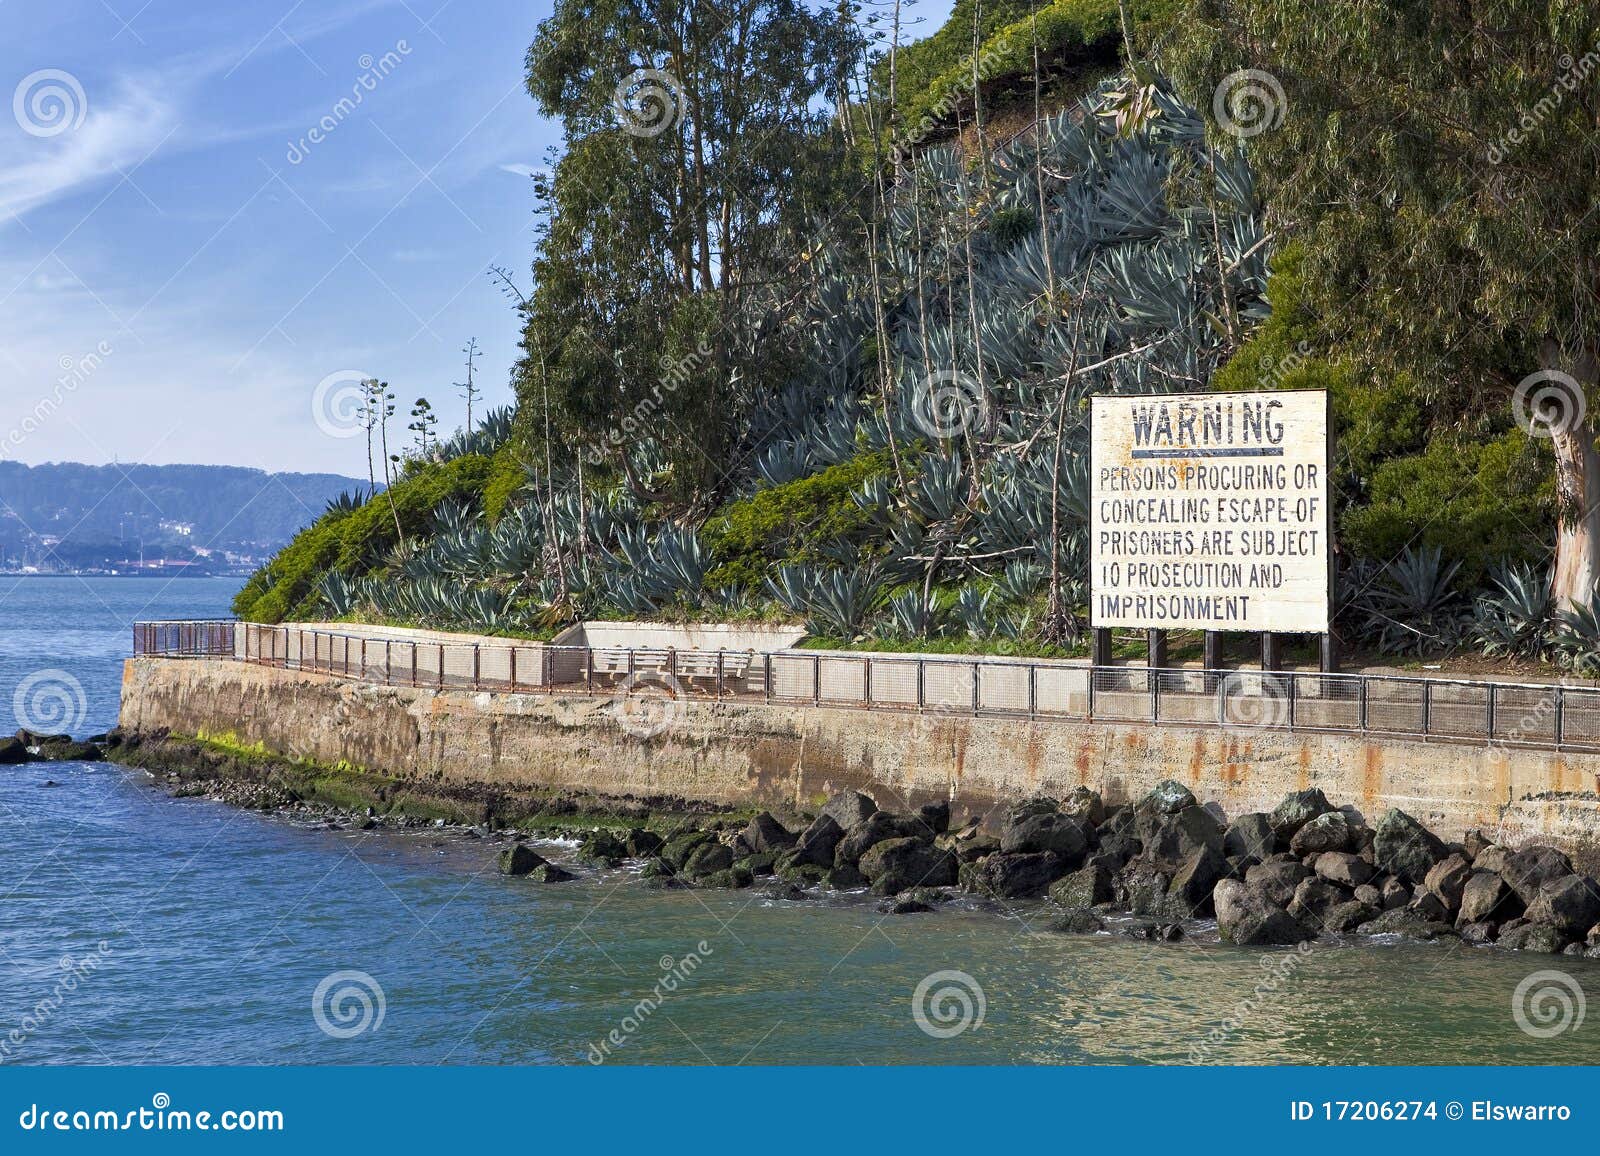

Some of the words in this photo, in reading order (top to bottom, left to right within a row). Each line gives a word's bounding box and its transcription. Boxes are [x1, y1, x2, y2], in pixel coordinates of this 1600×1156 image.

[1131, 400, 1284, 446] WARNING
[1100, 465, 1177, 491] PERSONS
[1185, 464, 1286, 490] PROCURING
[1294, 464, 1318, 489] OR
[1101, 498, 1210, 523] CONCEALING
[1217, 498, 1288, 523] ESCAPE
[1297, 498, 1319, 523] OF
[1100, 531, 1194, 555] PRISONERS
[1200, 531, 1233, 556] ARE
[1240, 531, 1318, 556] SUBJECT
[1127, 562, 1242, 588] PROSECUTION
[1249, 563, 1282, 588] AND
[1100, 595, 1250, 620] IMPRISONMENT
